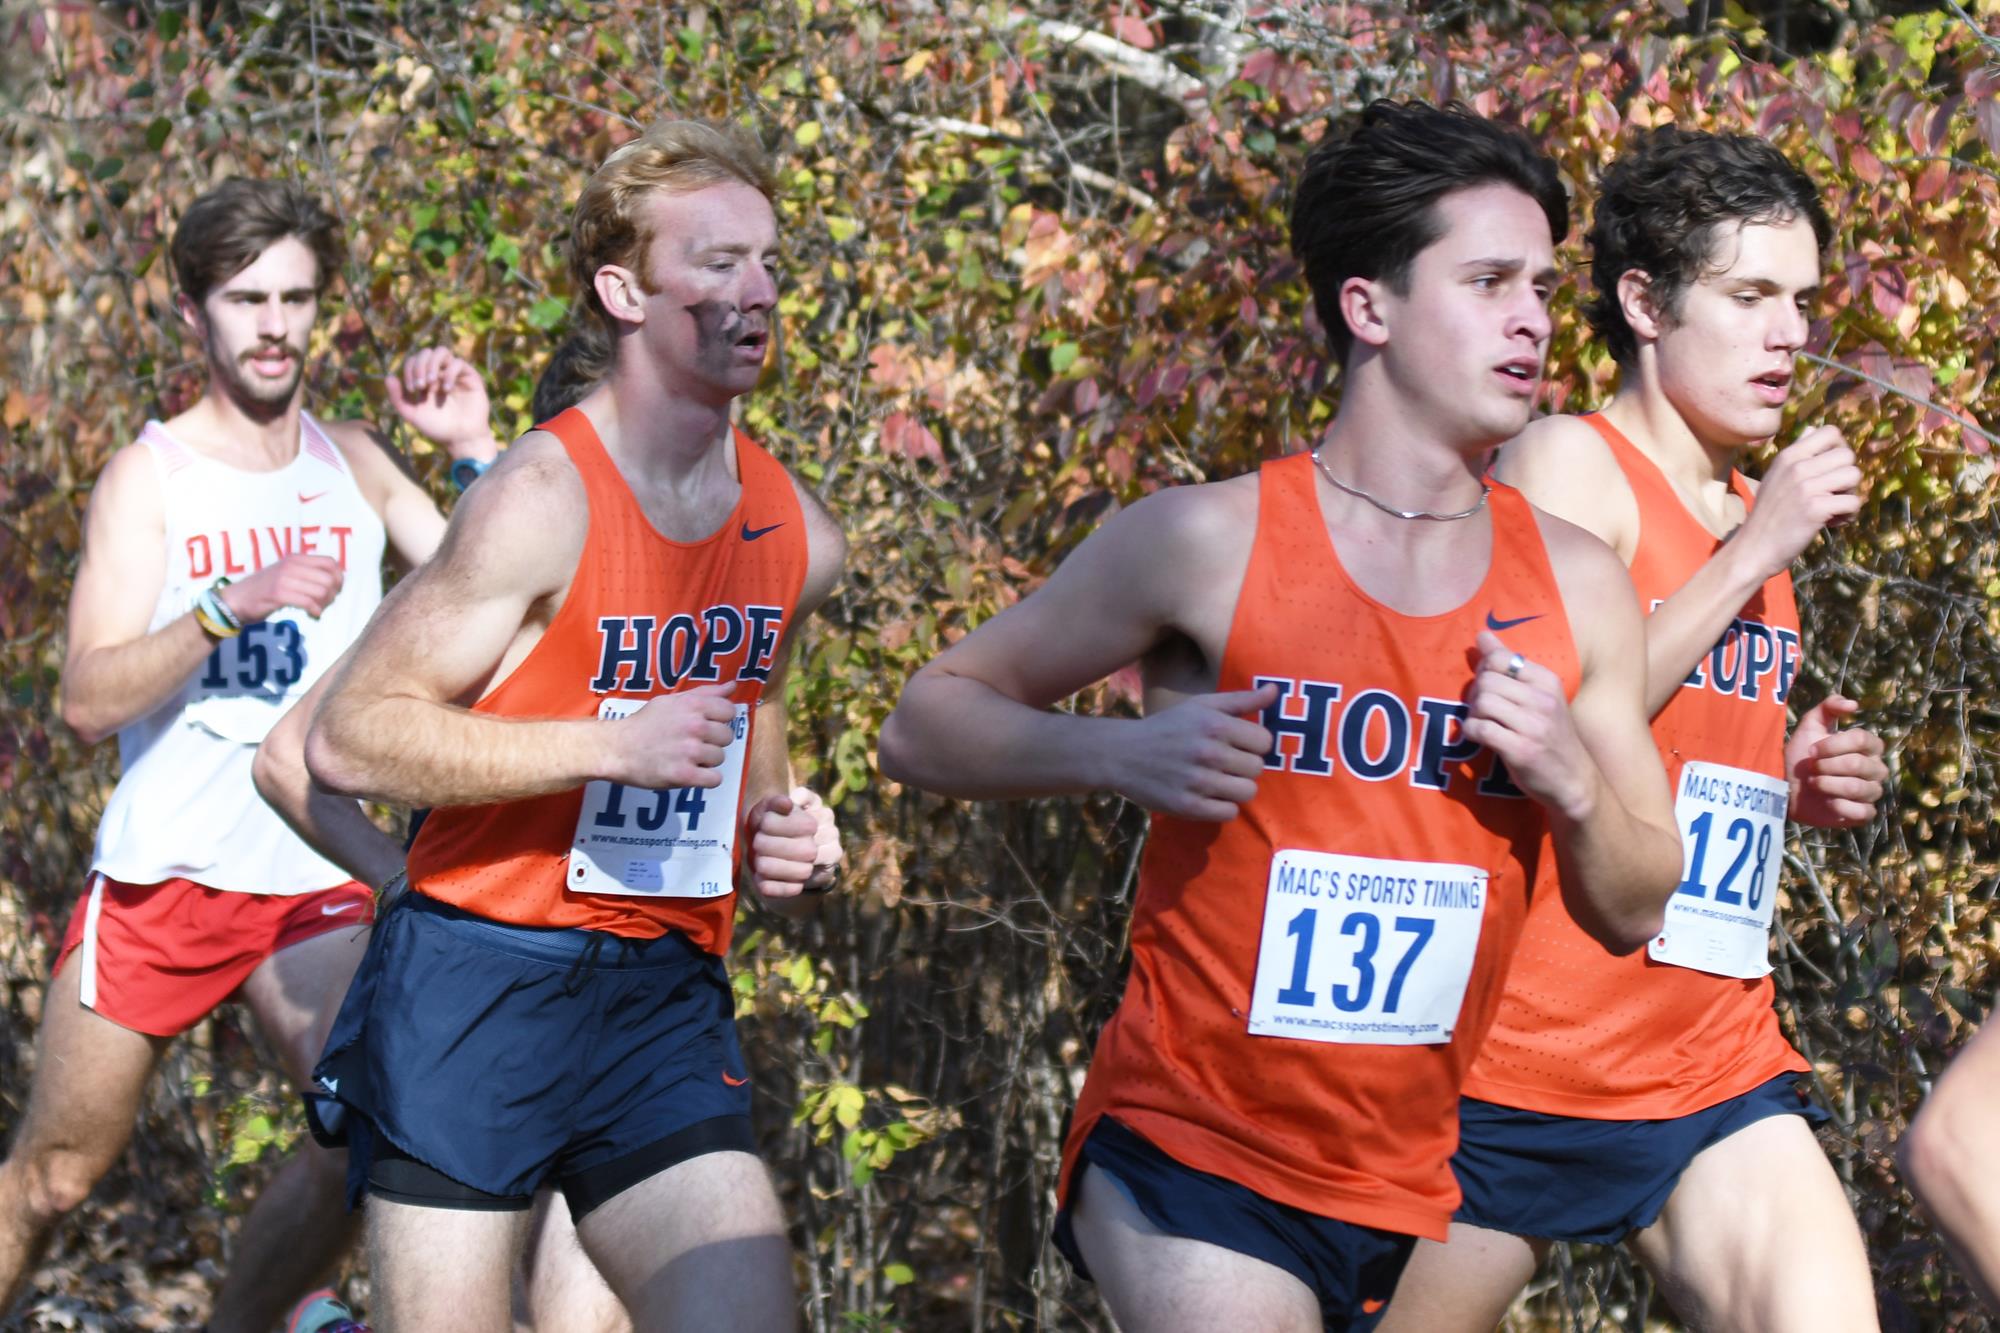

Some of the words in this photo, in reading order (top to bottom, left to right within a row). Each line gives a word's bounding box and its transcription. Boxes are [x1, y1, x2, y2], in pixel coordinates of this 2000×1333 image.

[184, 525, 352, 579] OLIVET
[201, 619, 304, 689] 153
[589, 604, 784, 693] HOPE
[1650, 599, 1800, 705] OPE
[1252, 675, 1531, 799] HOP
[1683, 773, 1732, 805] MAC'S
[590, 833, 718, 850] www.macssportstiming.com
[1677, 811, 1772, 911] 128
[700, 881, 719, 895] 134
[1276, 864, 1341, 898] MAC'S
[1345, 873, 1417, 906] SPORTS
[1423, 880, 1480, 909] TIMING
[1277, 908, 1436, 1013] 137
[1273, 1015, 1439, 1036] www.macssportstiming.com
